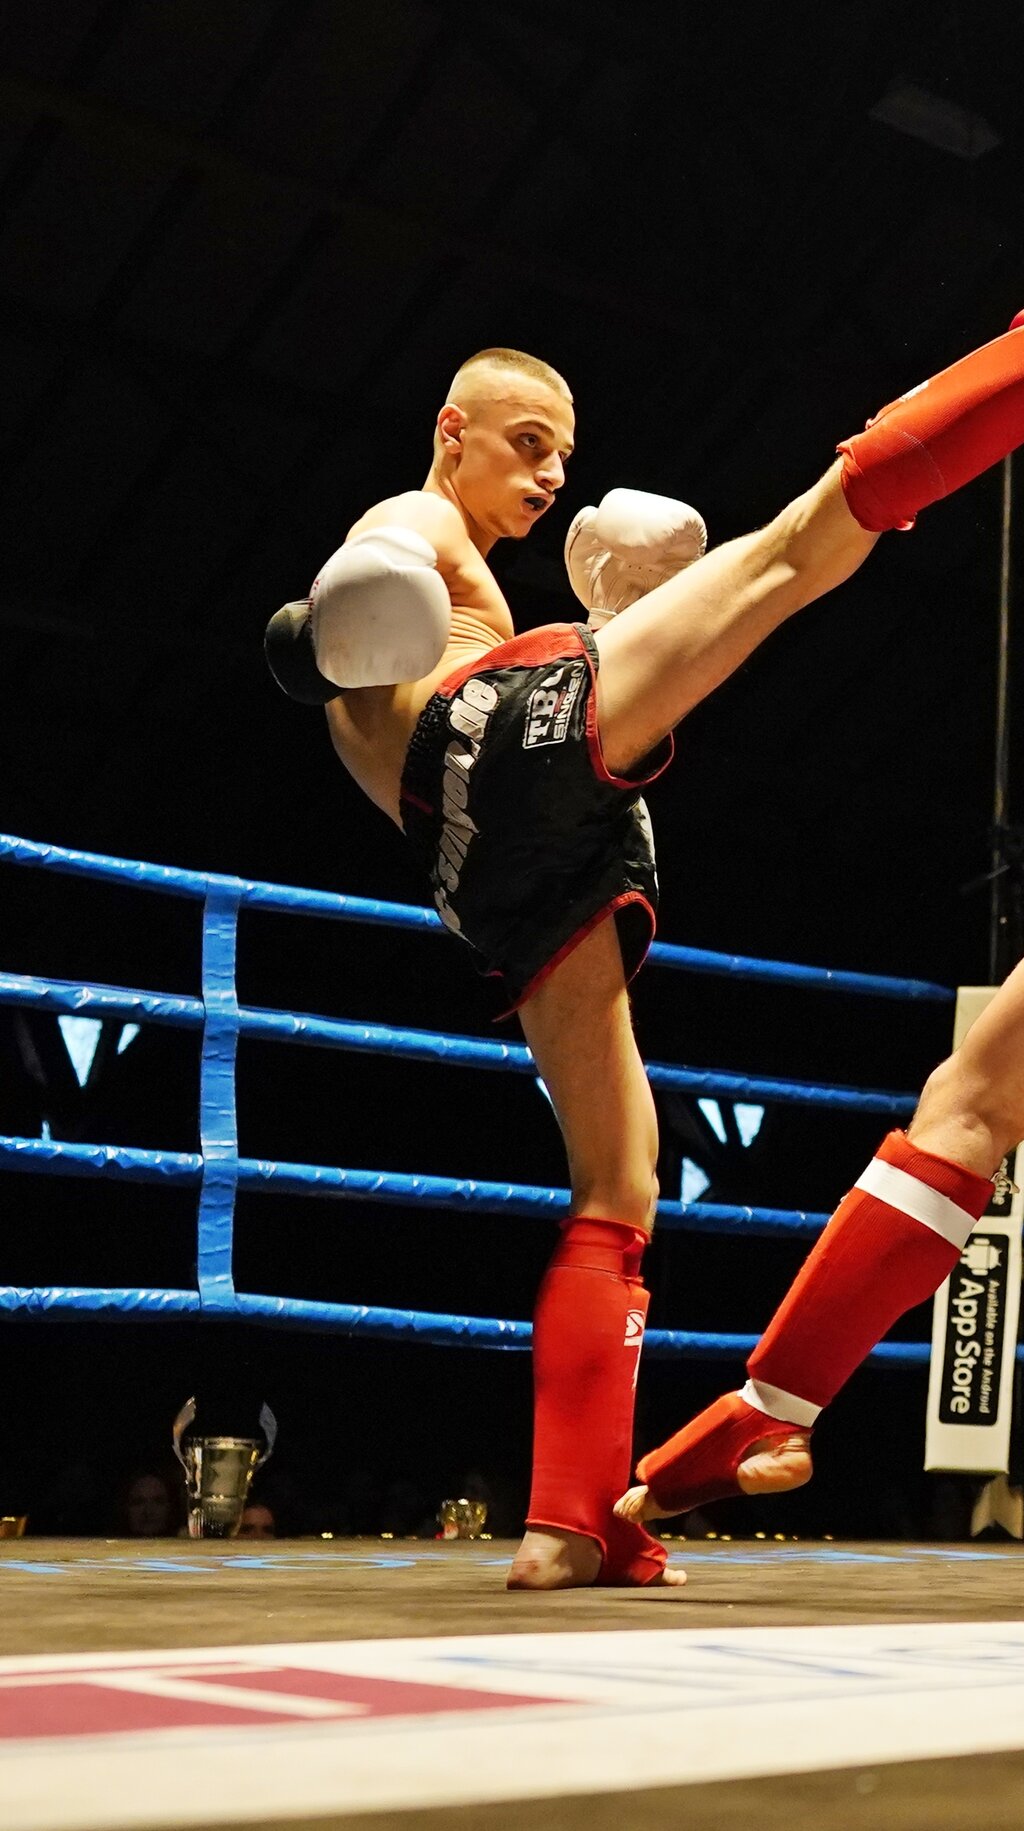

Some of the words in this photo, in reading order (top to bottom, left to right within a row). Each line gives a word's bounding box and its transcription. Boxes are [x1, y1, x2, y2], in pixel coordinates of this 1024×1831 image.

[553, 662, 584, 739] SINGEN
[951, 1278, 985, 1337] App
[985, 1279, 1000, 1329] Available
[982, 1348, 995, 1366] the
[985, 1331, 996, 1345] on
[950, 1340, 981, 1414] Store
[979, 1368, 993, 1413] Android
